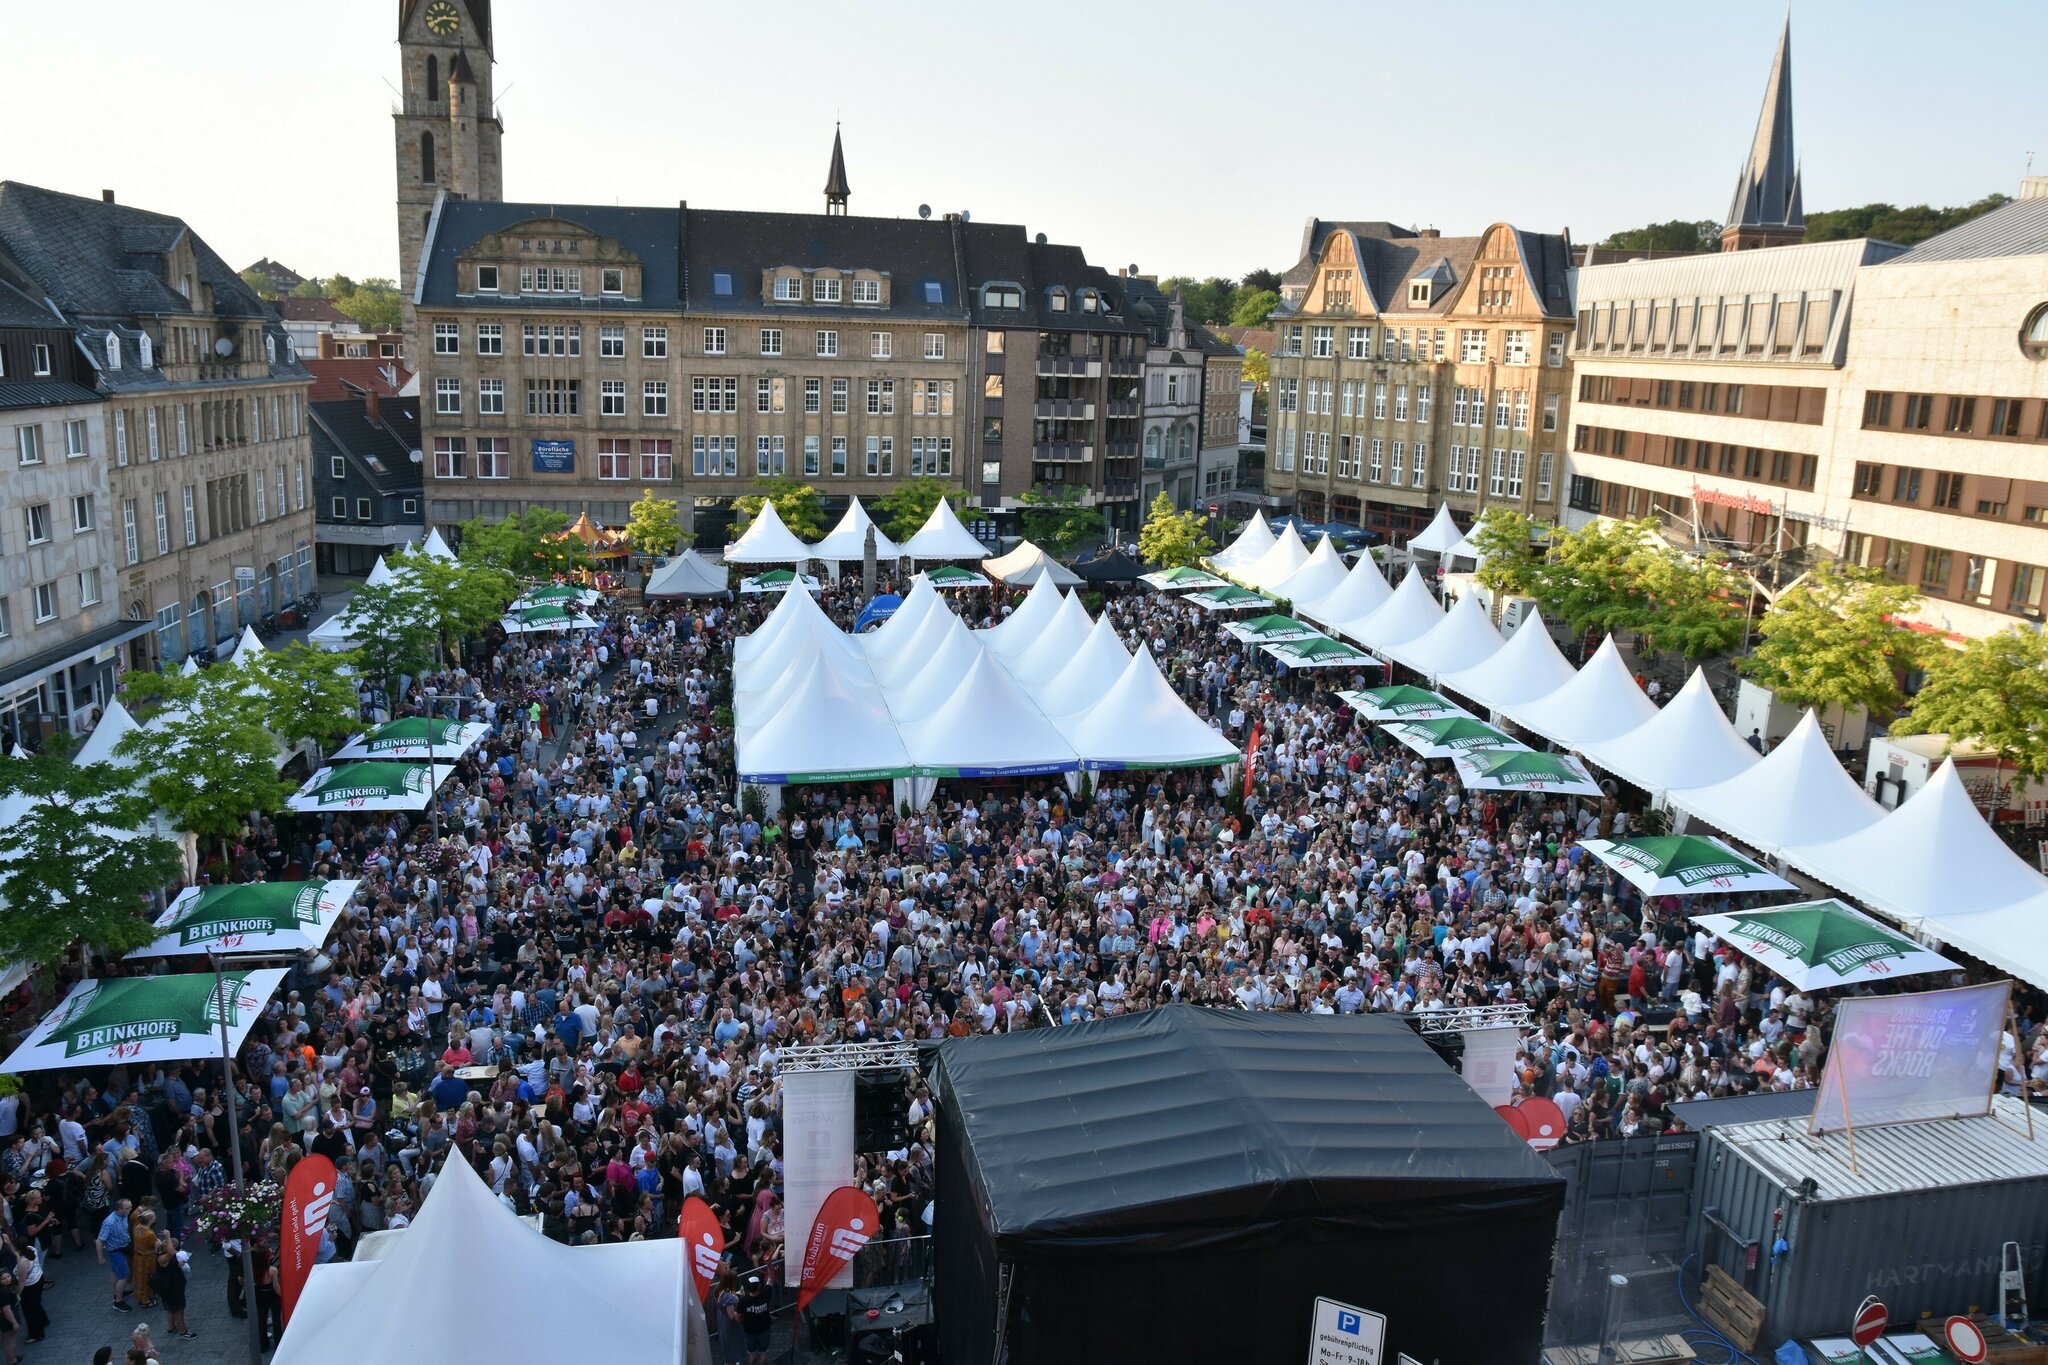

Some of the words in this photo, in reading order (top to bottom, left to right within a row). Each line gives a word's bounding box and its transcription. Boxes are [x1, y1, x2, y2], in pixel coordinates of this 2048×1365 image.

[807, 1223, 824, 1266] Clubraum
[1342, 1314, 1355, 1329] P
[1320, 1334, 1374, 1355] gebührenpflichtig
